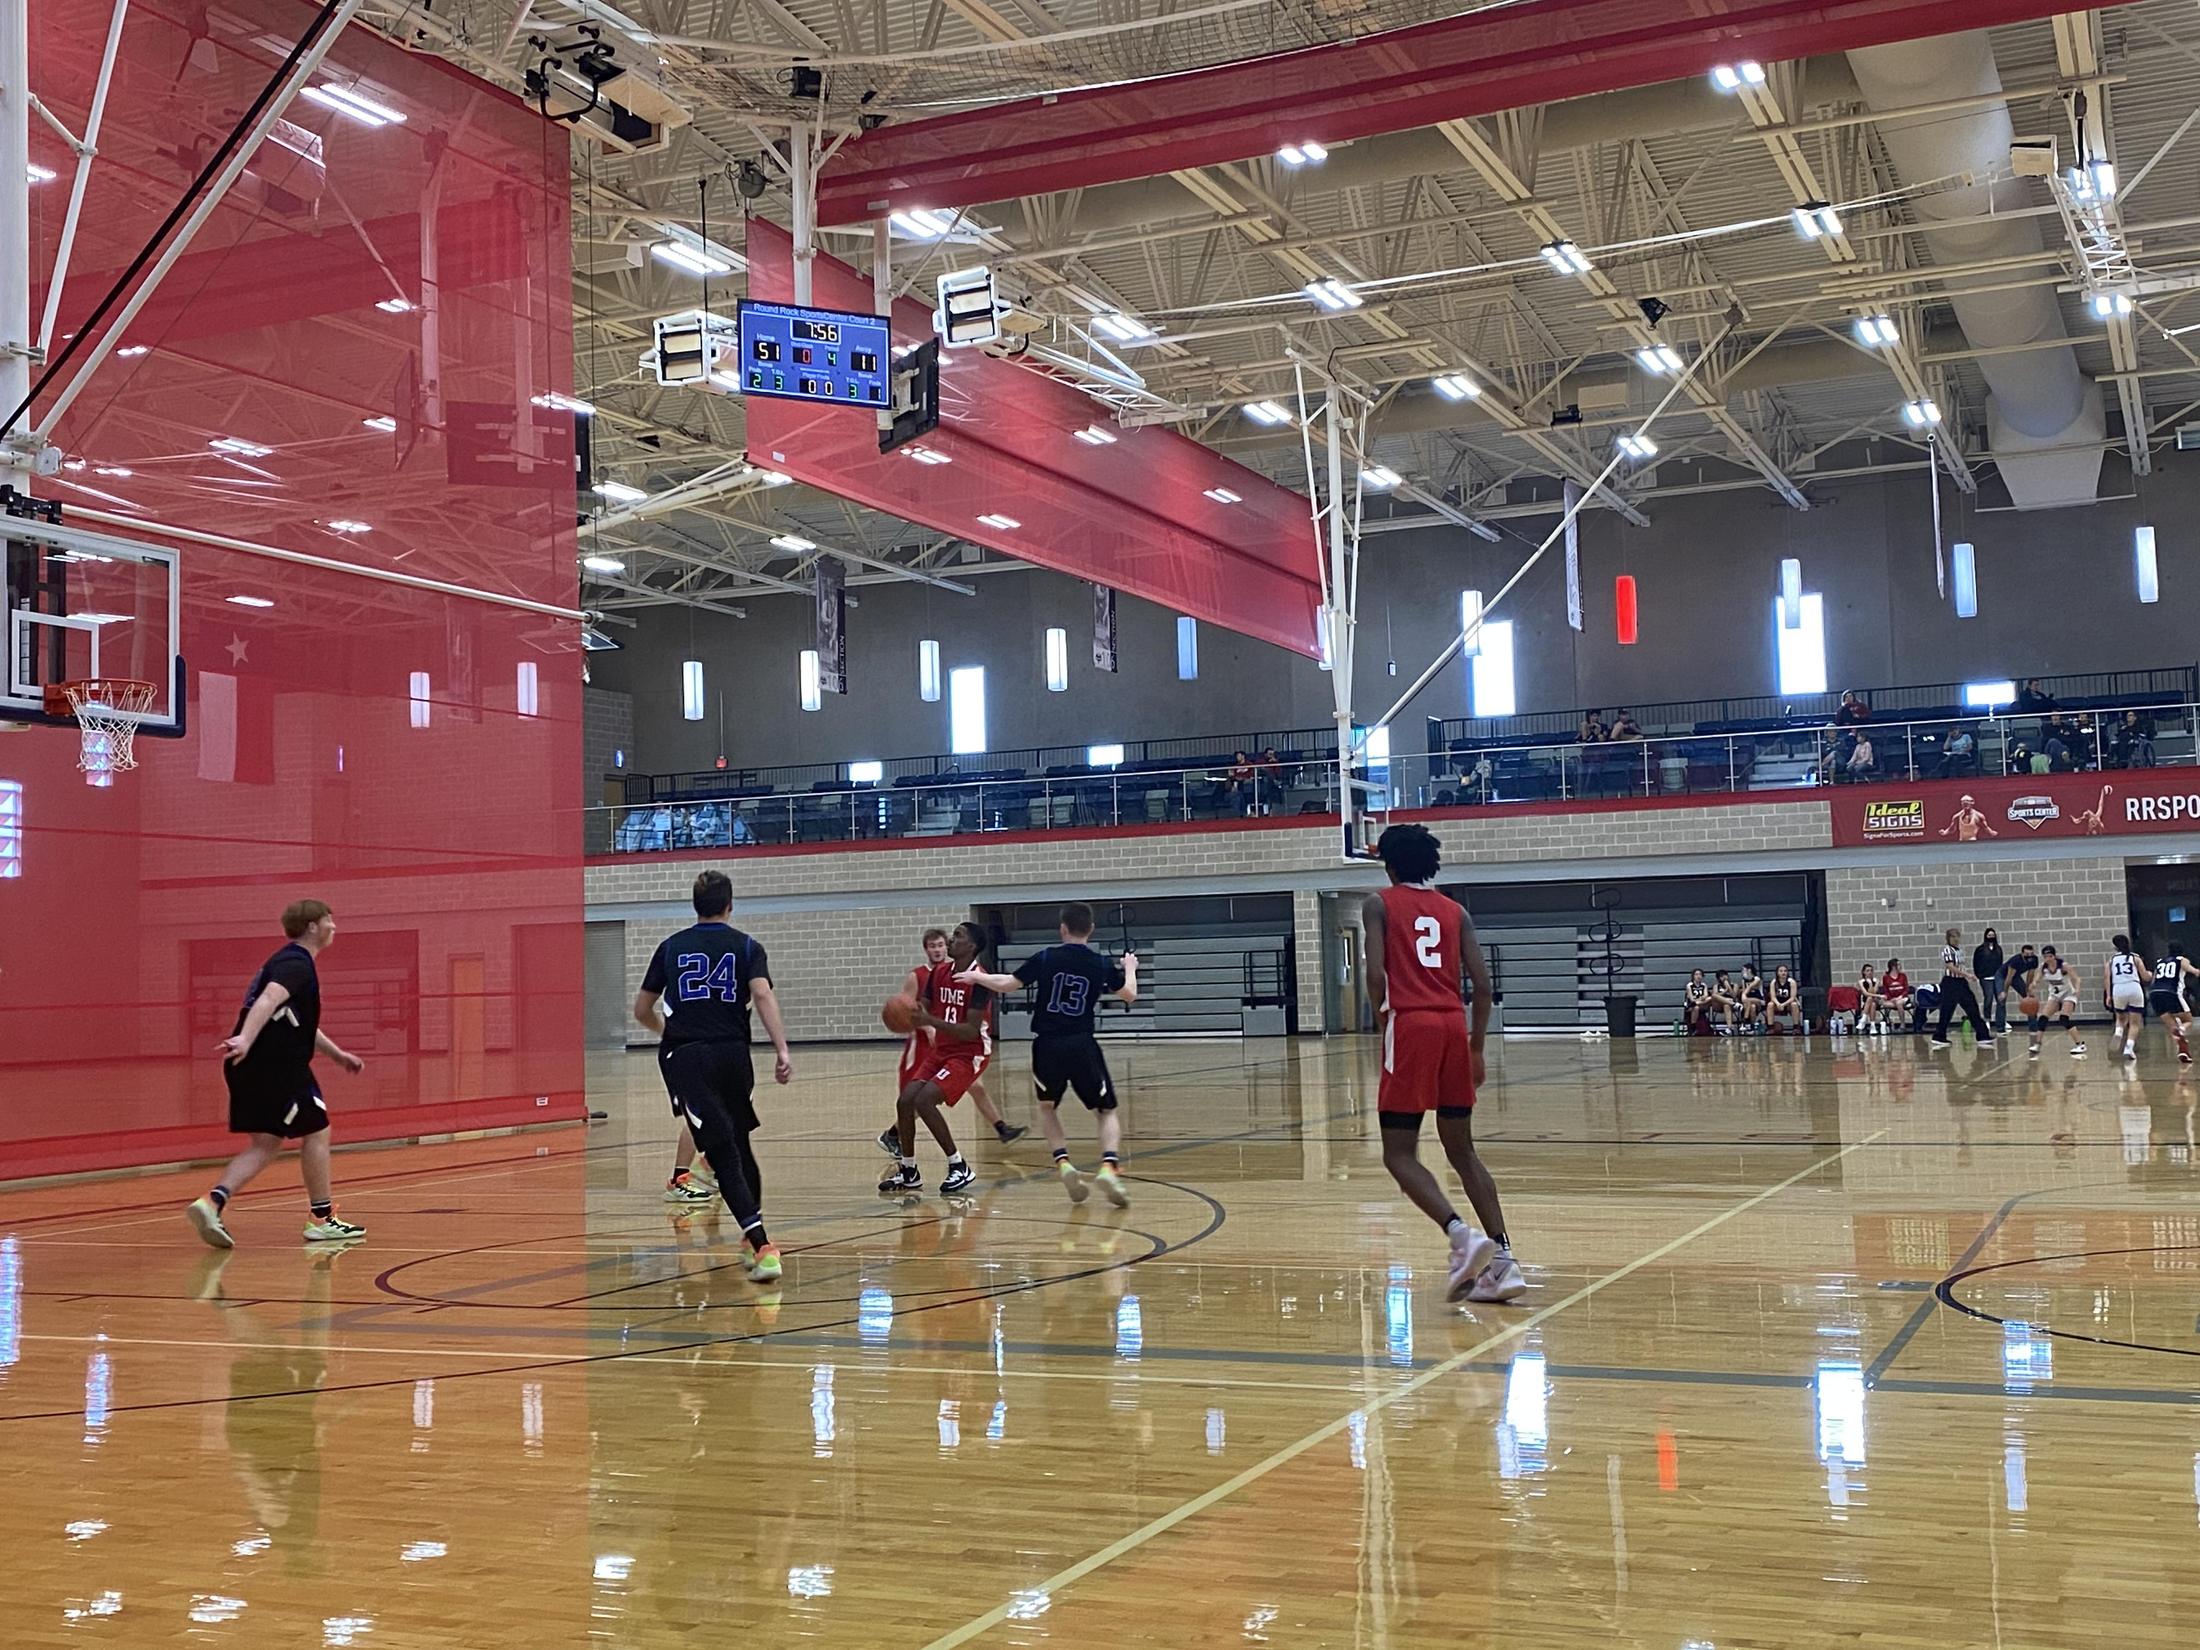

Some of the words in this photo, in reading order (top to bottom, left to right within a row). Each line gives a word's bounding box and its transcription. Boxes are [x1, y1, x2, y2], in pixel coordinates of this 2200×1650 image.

[754, 303, 779, 314] Round
[780, 306, 800, 317] Rock
[849, 315, 870, 324] Court
[870, 317, 876, 325] 2
[805, 322, 838, 341] 7:56
[758, 342, 780, 360] 51
[803, 348, 811, 364] 0
[828, 352, 836, 365] 4
[861, 354, 877, 371] 11
[753, 373, 762, 388] 2
[775, 375, 783, 390] 3
[808, 379, 817, 394] 0
[824, 381, 833, 396] 0
[849, 383, 857, 399] 3
[1868, 802, 1921, 817] Ideal
[2126, 794, 2200, 821] RRSPO
[1868, 814, 1922, 828] SIGNS
[1414, 916, 1442, 969] 2
[2115, 962, 2134, 975] 13
[2156, 961, 2177, 979] 30
[678, 953, 738, 1002] 24
[940, 986, 966, 1007] UME
[1046, 971, 1090, 1017] 13
[944, 1006, 957, 1024] 13
